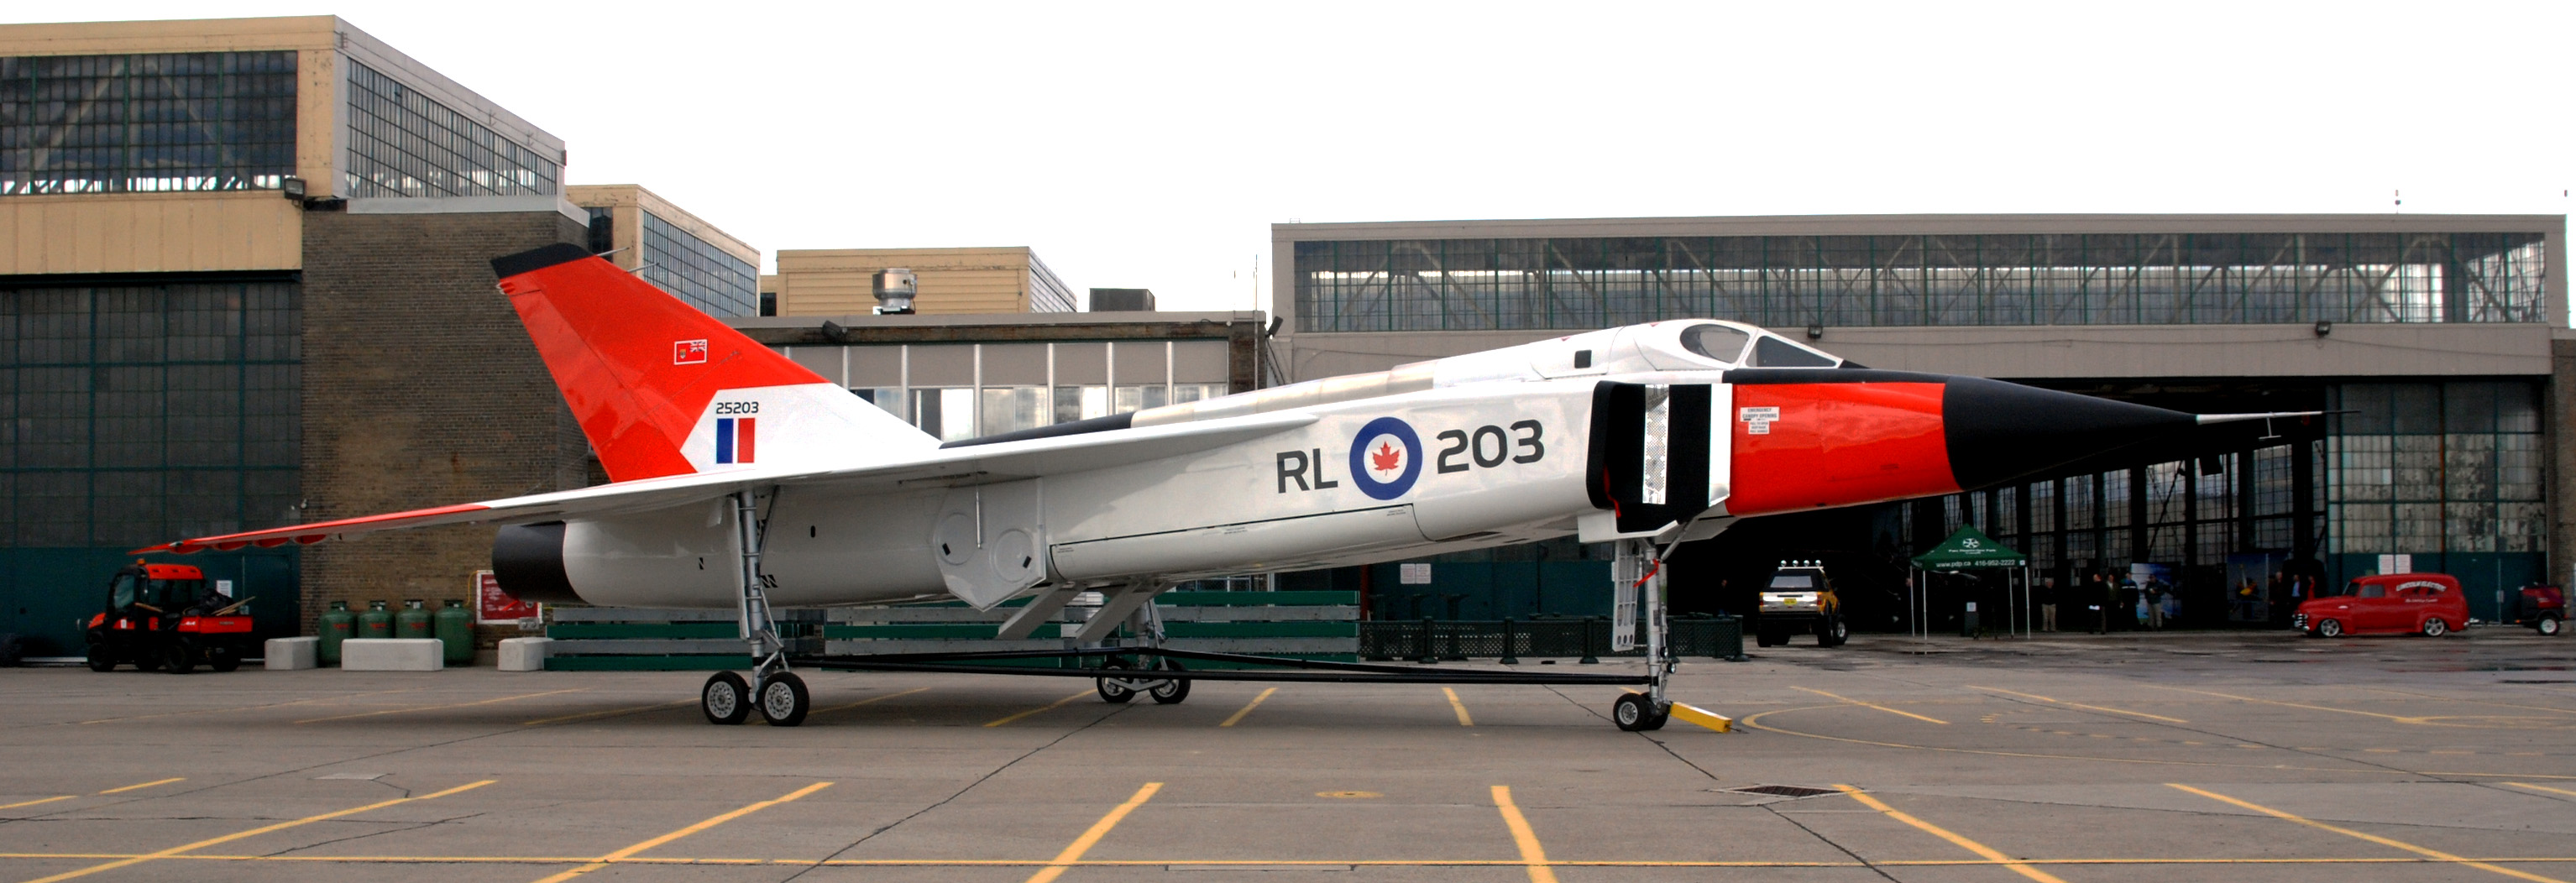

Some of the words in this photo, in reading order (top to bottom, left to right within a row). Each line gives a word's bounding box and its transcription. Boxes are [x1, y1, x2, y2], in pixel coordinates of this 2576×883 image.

[716, 401, 759, 414] 25203
[1276, 448, 1338, 494] RL
[1437, 420, 1545, 474] 203
